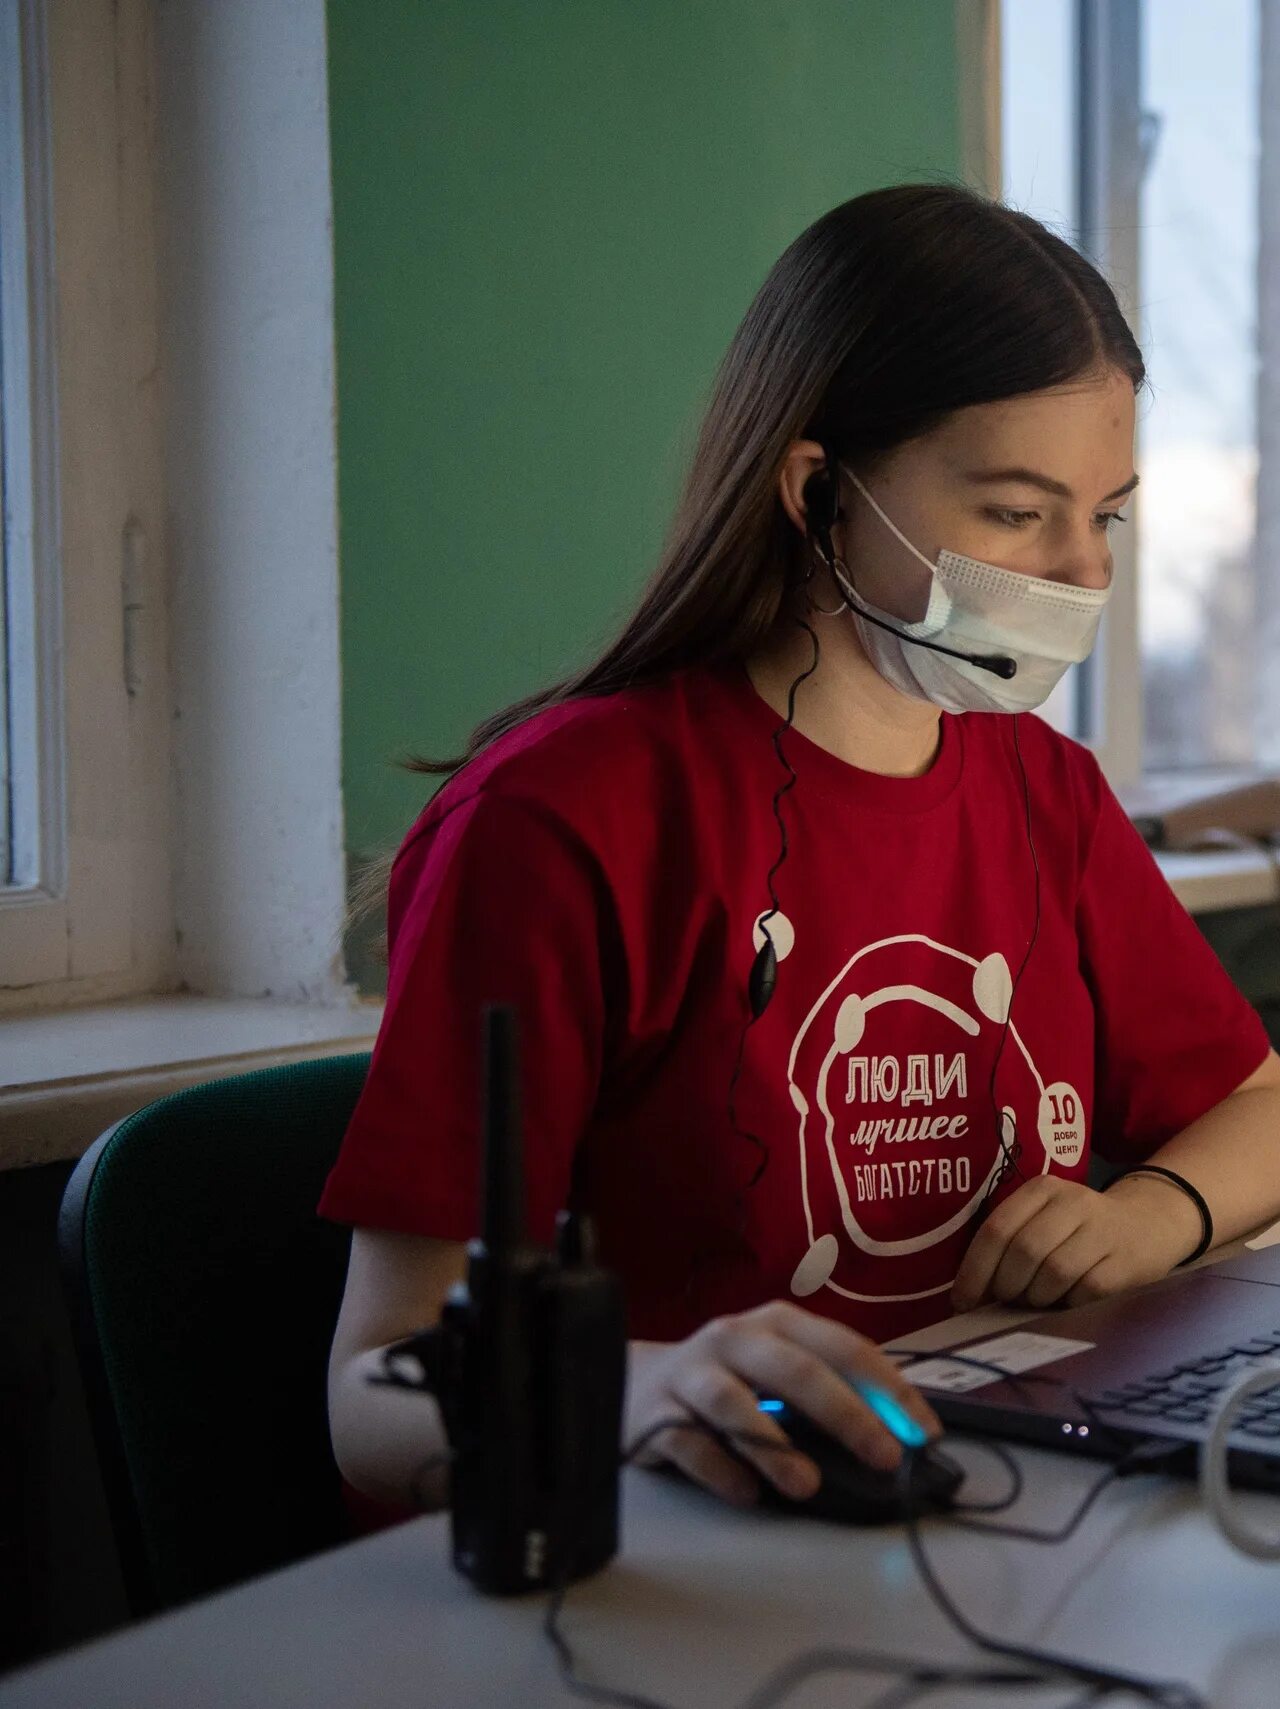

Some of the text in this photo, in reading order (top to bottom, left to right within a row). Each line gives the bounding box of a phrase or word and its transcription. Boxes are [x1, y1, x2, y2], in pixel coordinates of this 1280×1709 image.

[845, 1052, 968, 1107] ЛЮДИ
[1048, 1093, 1076, 1125] 10
[850, 1114, 969, 1155] лучшее
[854, 1156, 971, 1202] БОГАТСТВО
